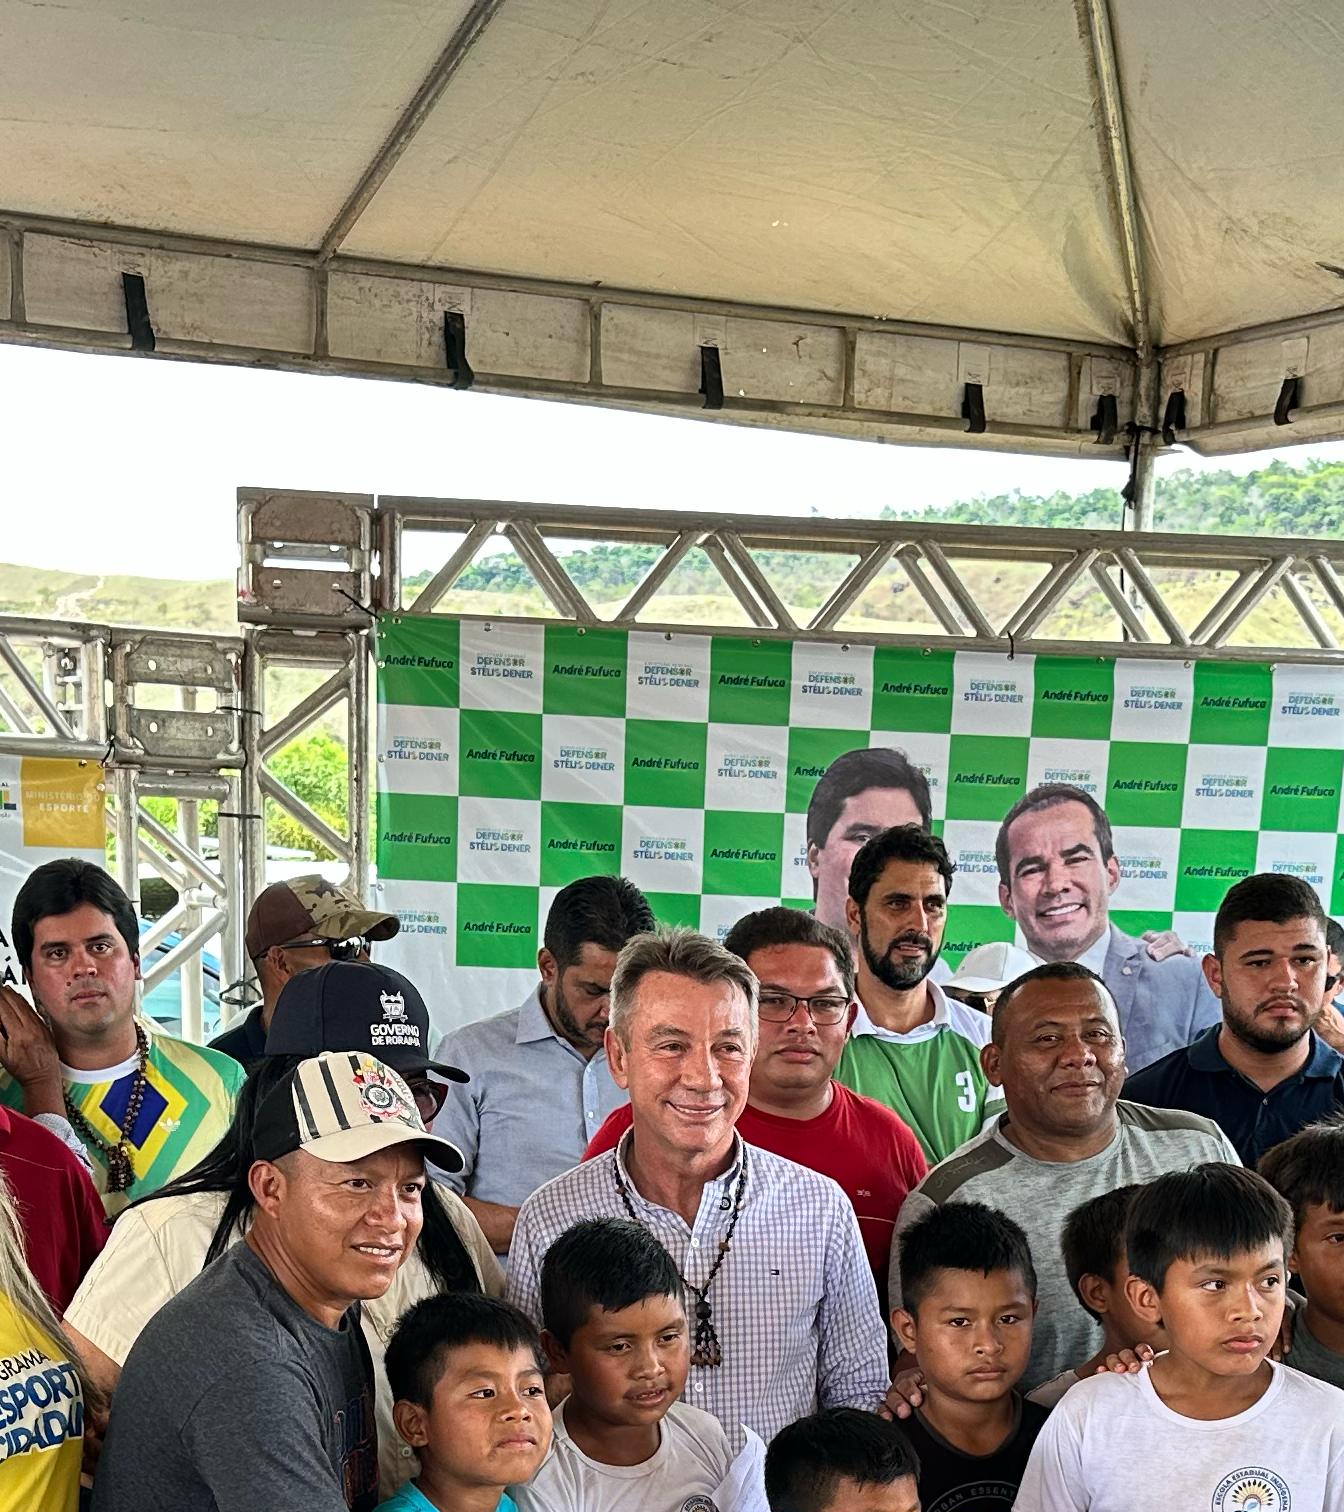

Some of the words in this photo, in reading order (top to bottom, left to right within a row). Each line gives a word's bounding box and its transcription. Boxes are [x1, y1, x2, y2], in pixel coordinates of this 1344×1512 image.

[385, 654, 416, 667] André
[418, 657, 453, 669] Fufuca
[552, 664, 584, 676] André
[585, 666, 621, 677] Fufuca
[718, 674, 750, 686] André
[750, 676, 786, 688] Fufuca
[881, 682, 912, 694] André
[913, 683, 948, 696] Fufuca
[1042, 689, 1073, 701] André
[1074, 691, 1109, 703] Fufuca
[1201, 696, 1231, 708] André
[1232, 698, 1267, 709] Fufuca
[466, 749, 498, 761] André
[499, 750, 535, 762] Fufuca
[632, 757, 663, 769] André
[663, 758, 699, 771] Fufuca
[954, 773, 985, 785] André
[985, 774, 1020, 786] Fufuca
[1270, 785, 1300, 796] André
[1300, 786, 1335, 798] Fufuca
[710, 848, 741, 859] André
[741, 849, 776, 861] Fufuca
[464, 921, 495, 933] André
[496, 922, 531, 934] Fufuca
[370, 1024, 419, 1036] GOVERNO
[372, 1037, 384, 1046] DE
[955, 1070, 977, 1113] 3
